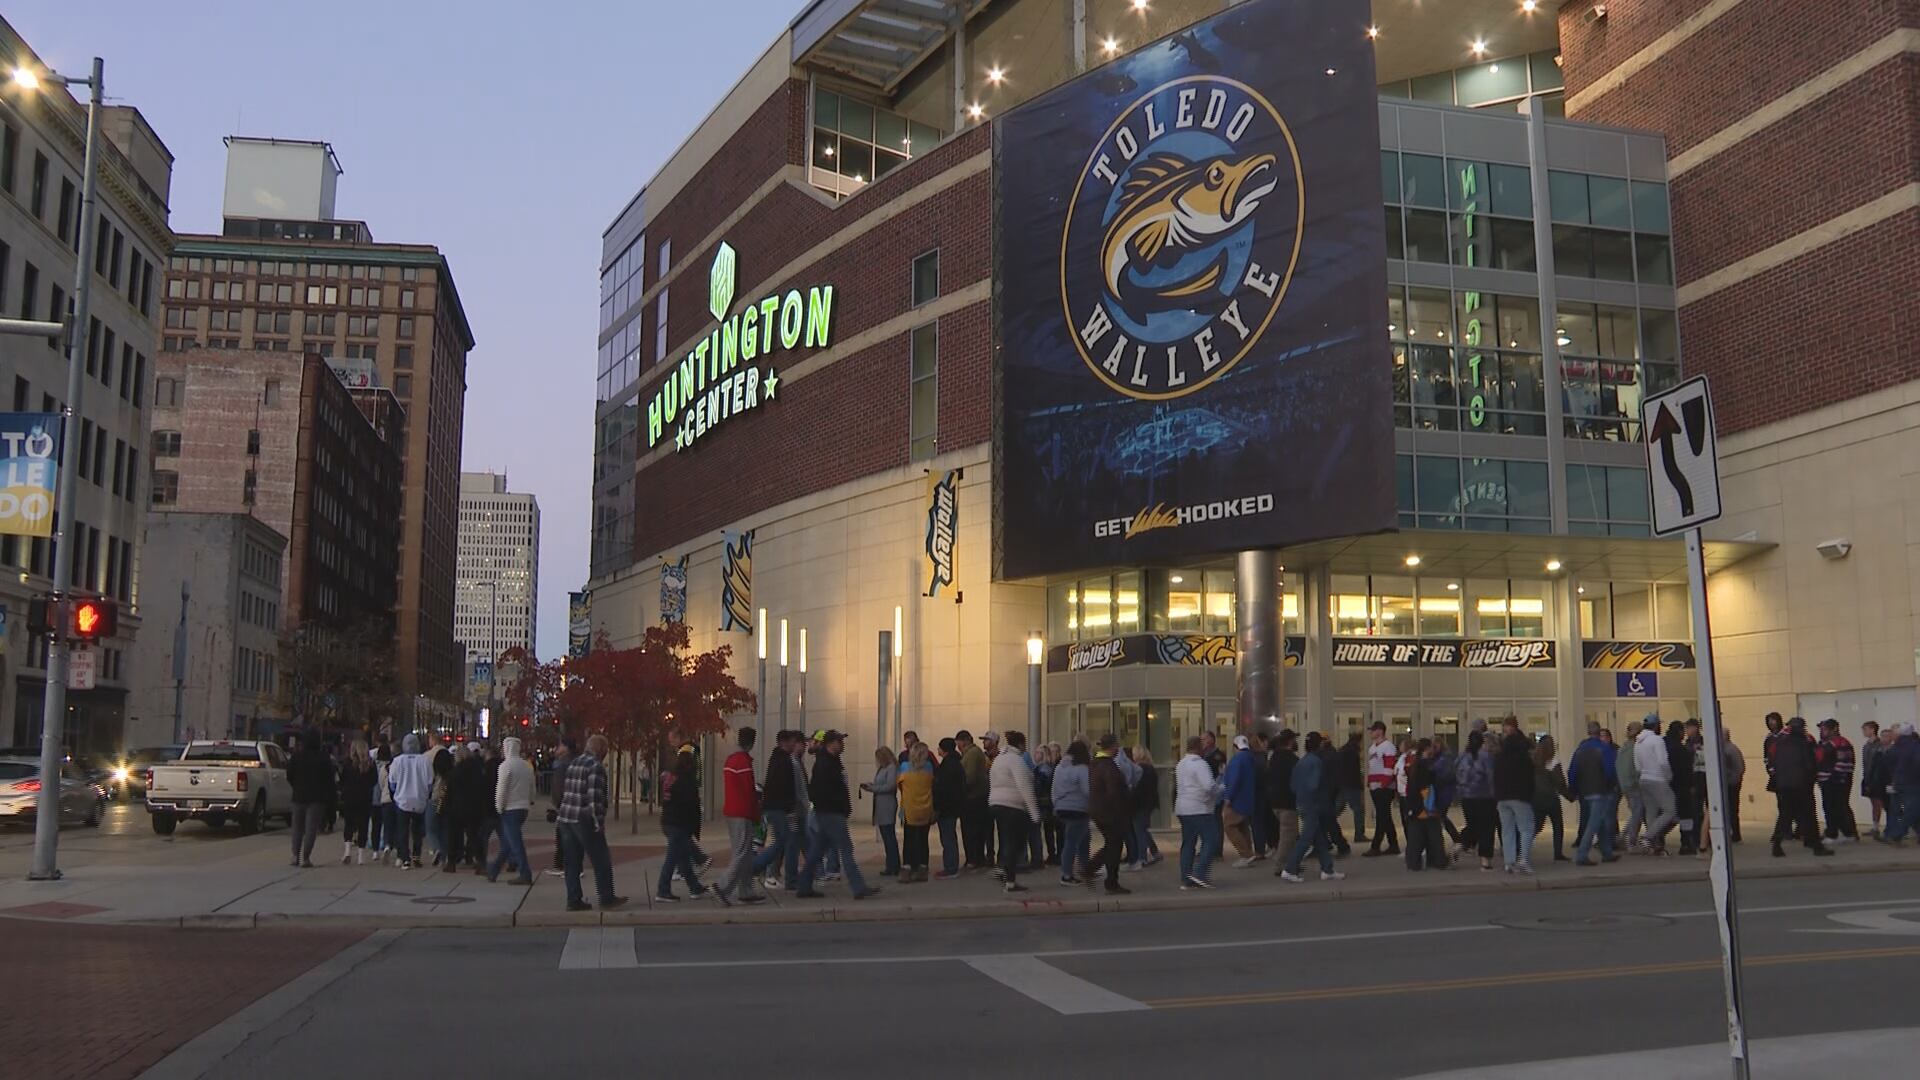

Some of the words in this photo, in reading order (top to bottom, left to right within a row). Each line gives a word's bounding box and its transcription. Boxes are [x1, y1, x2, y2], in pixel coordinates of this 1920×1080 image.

[1091, 87, 1257, 188] TOLEDO
[1080, 262, 1281, 387] WALLEYE
[648, 285, 834, 448] HUNTINGTON
[683, 370, 759, 447] CENTER
[1, 432, 54, 458] TO
[8, 462, 44, 487] LE
[0, 493, 49, 520] DO
[1094, 516, 1134, 538] GET
[1177, 494, 1274, 525] HOOKED
[1071, 640, 1121, 670] Walleye
[1334, 643, 1390, 662] HOME
[1392, 643, 1418, 662] OF
[1421, 644, 1456, 662] THE
[1465, 642, 1543, 668] Walleye
